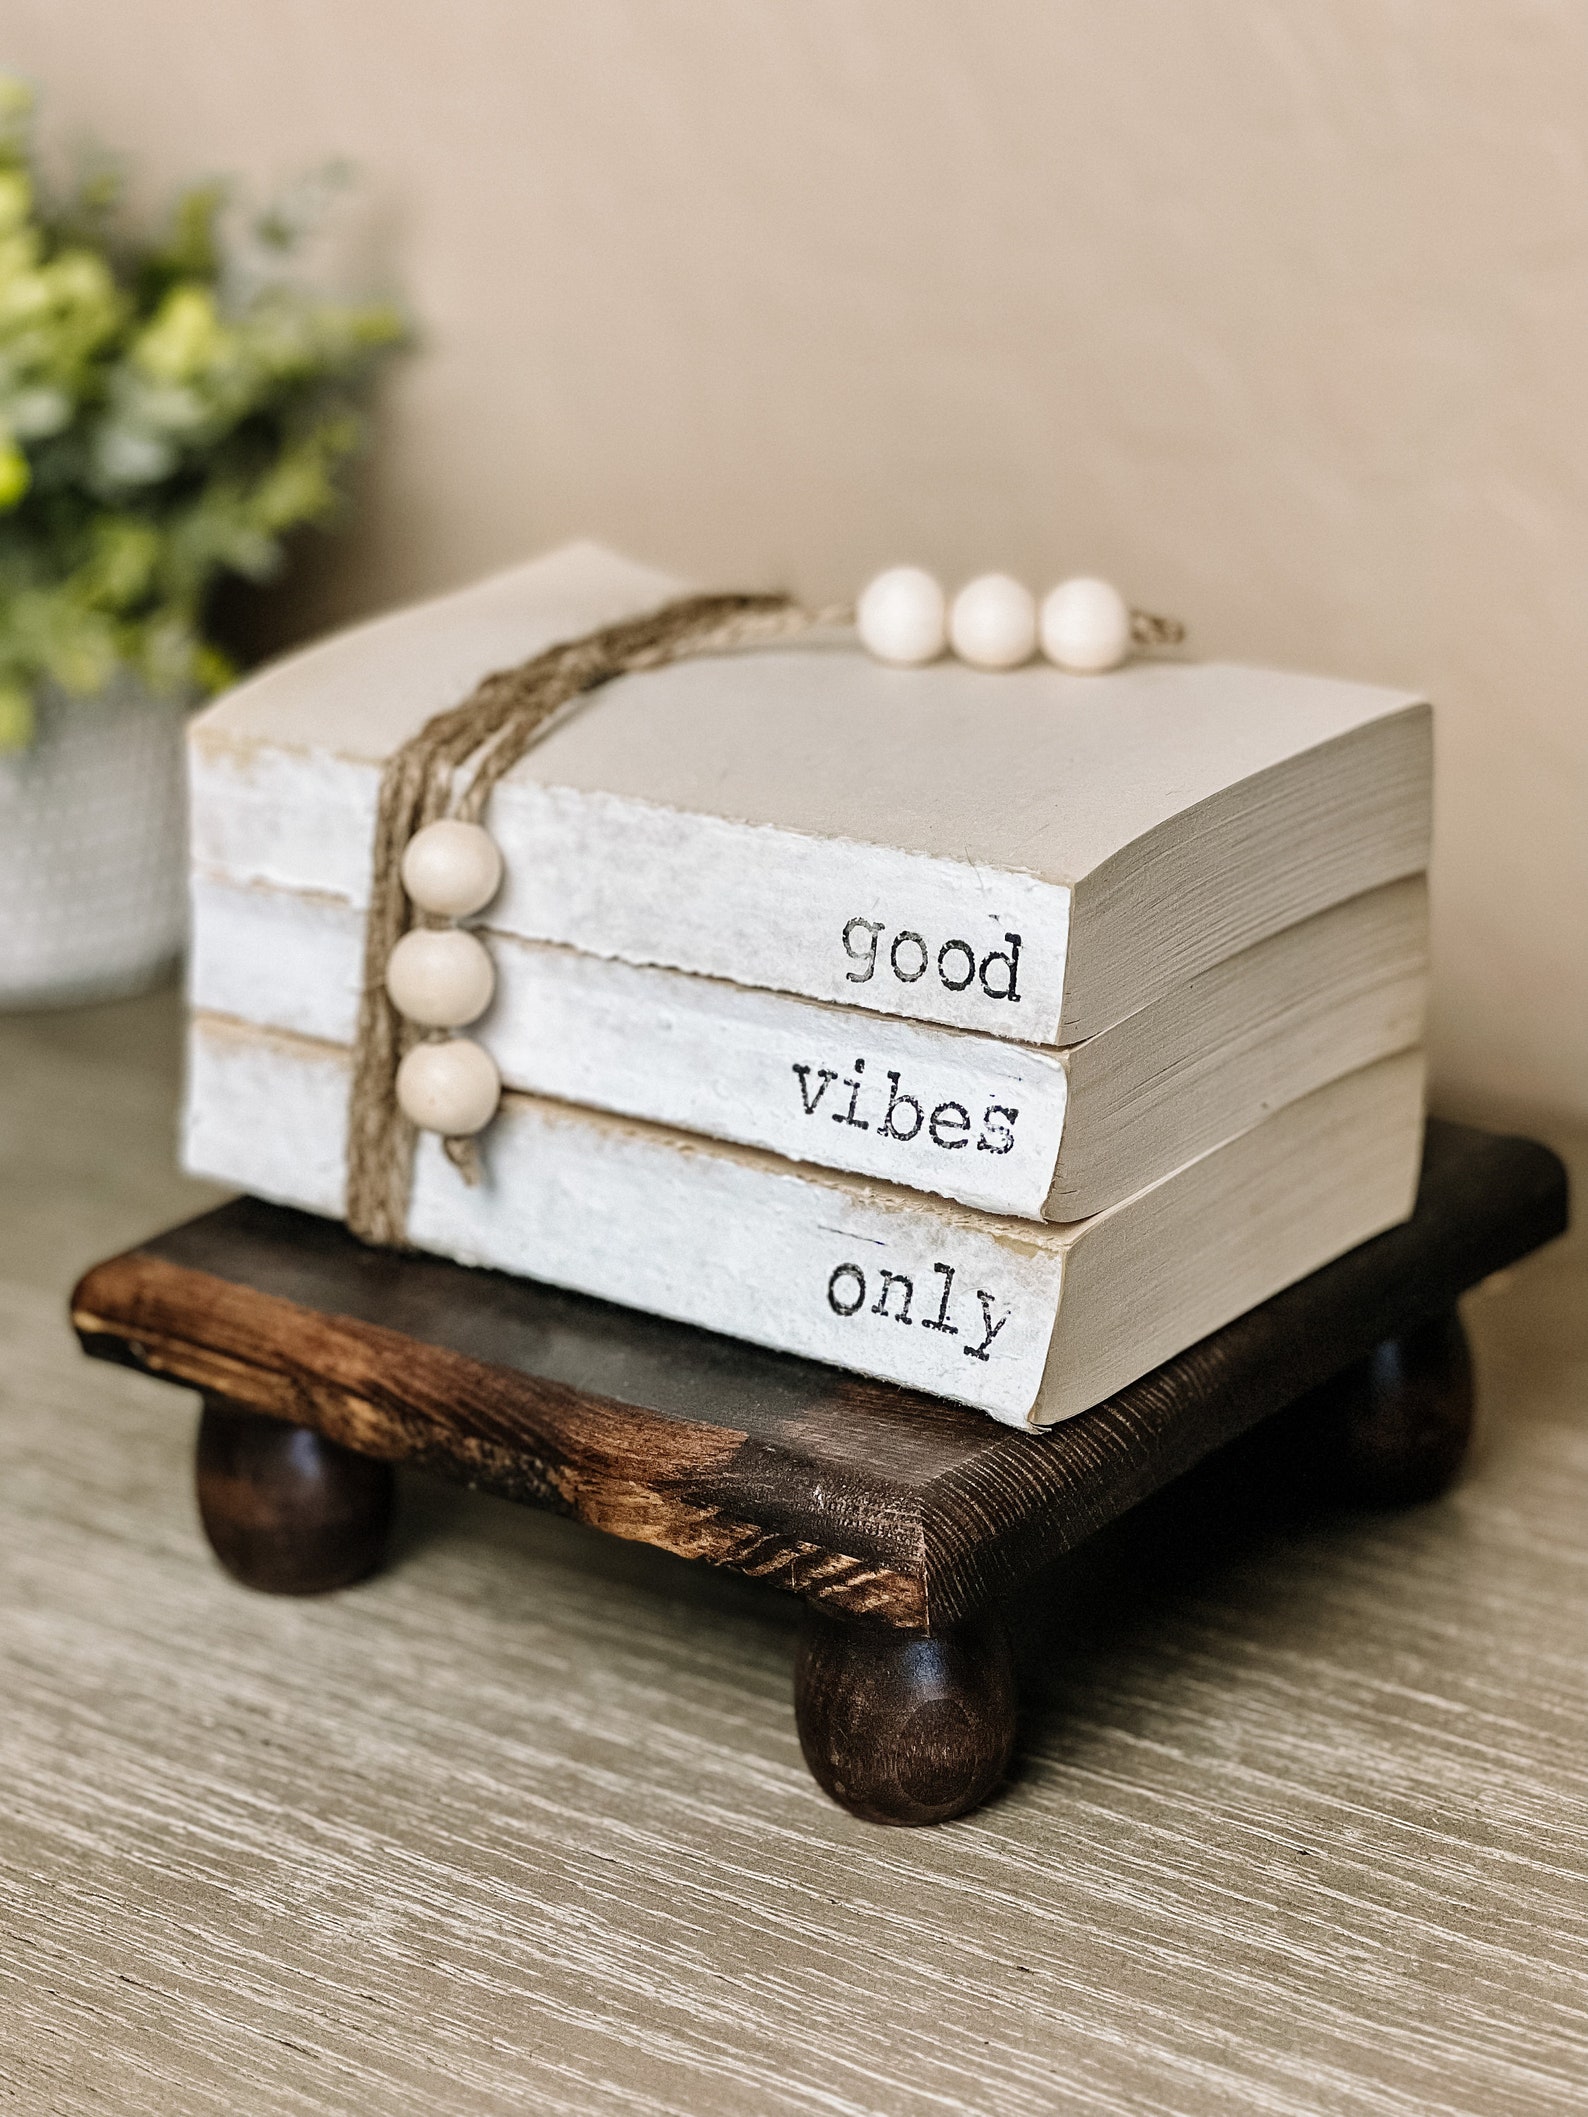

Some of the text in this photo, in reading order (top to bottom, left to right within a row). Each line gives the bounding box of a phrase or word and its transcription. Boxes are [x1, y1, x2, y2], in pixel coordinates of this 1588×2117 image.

[841, 916, 1022, 1003] good
[792, 1058, 1020, 1155] vibes
[827, 1261, 1011, 1362] only
